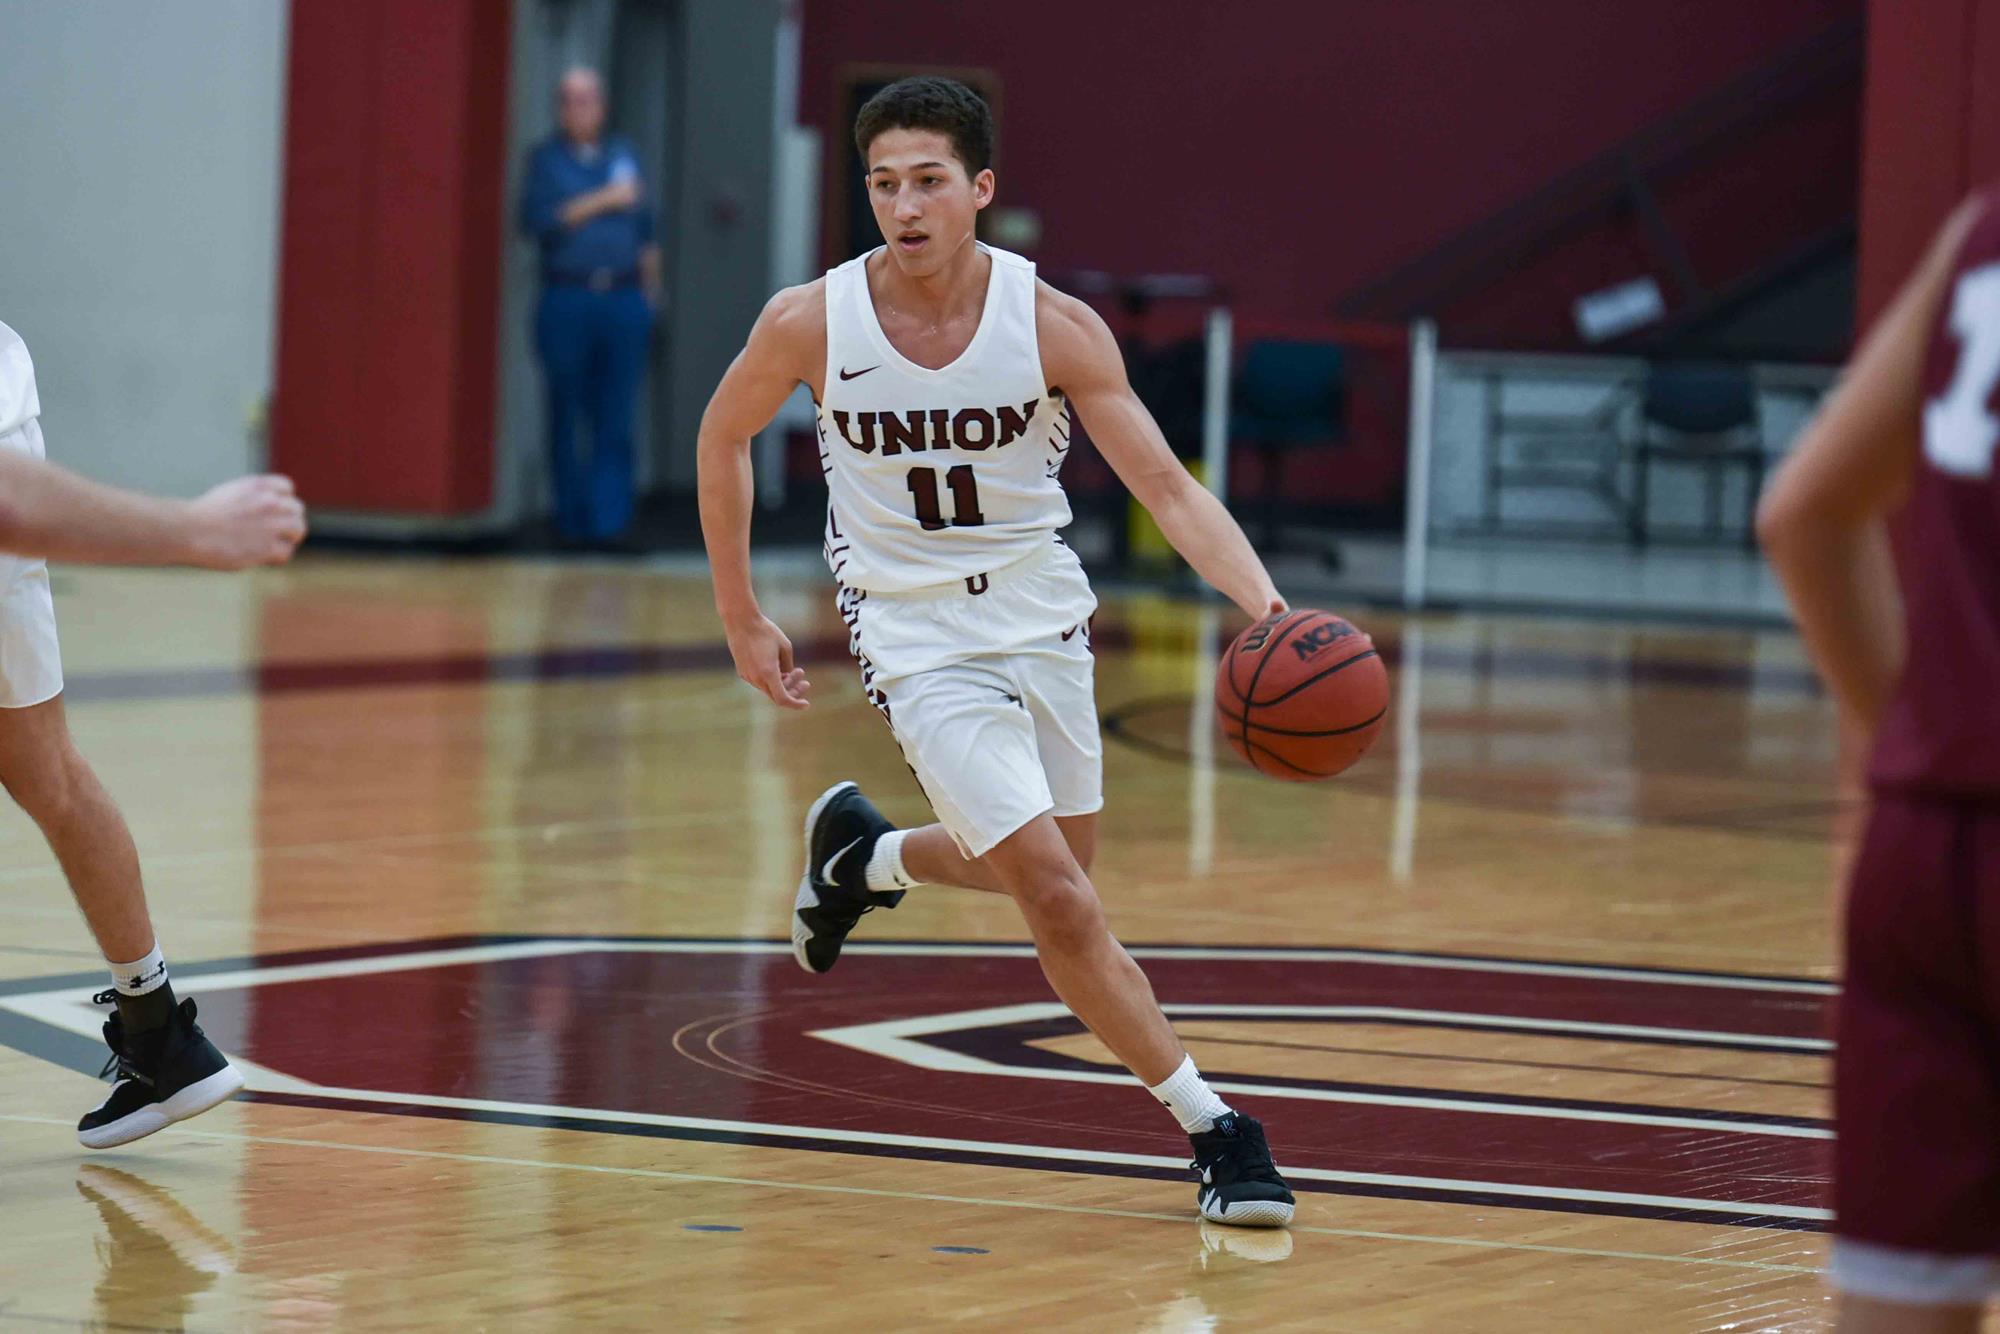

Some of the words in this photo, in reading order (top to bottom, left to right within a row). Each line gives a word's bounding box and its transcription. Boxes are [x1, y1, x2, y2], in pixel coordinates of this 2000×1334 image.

[832, 398, 1040, 456] UNION
[906, 464, 984, 530] 11
[965, 572, 988, 595] U
